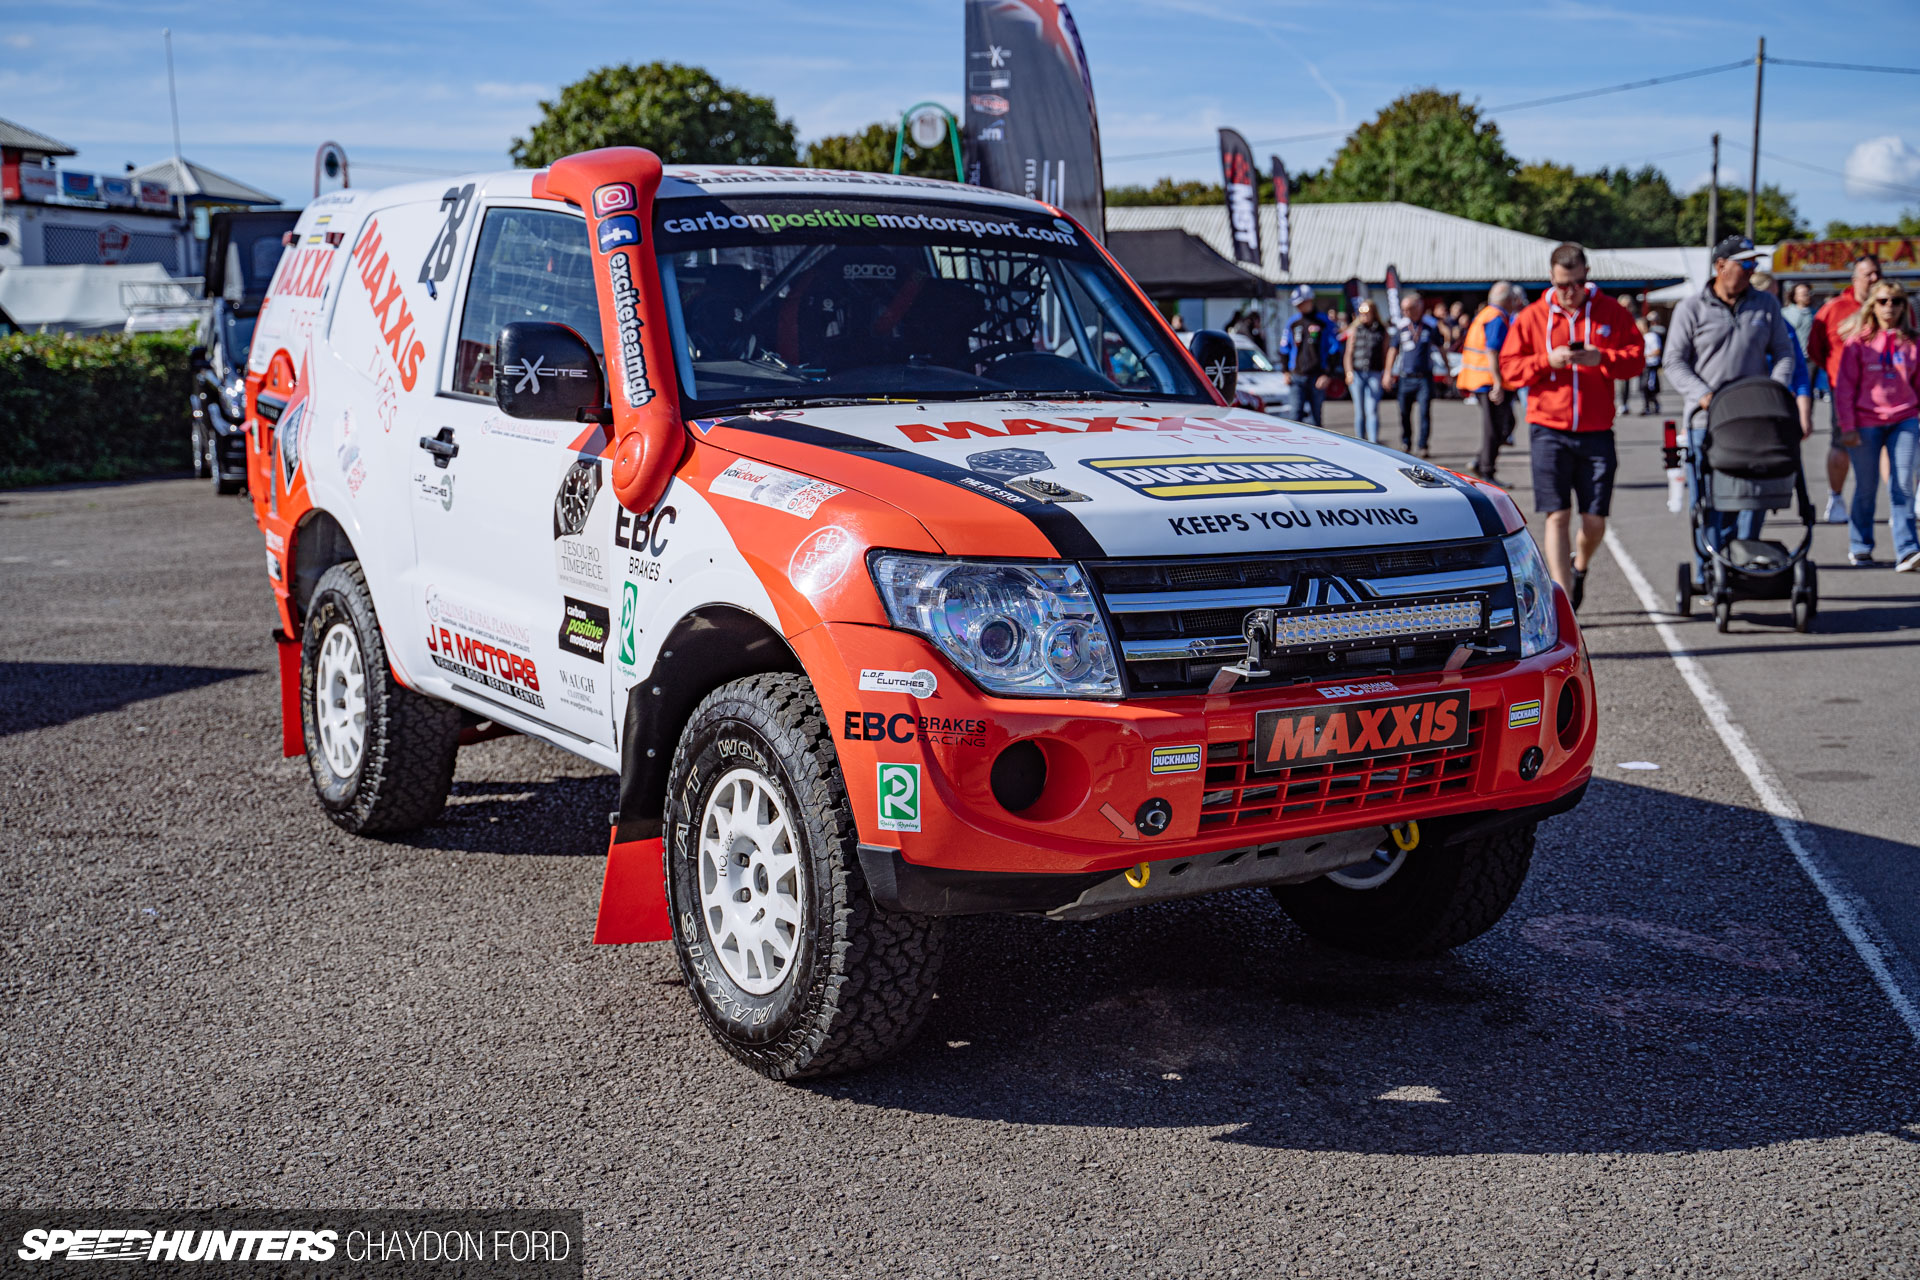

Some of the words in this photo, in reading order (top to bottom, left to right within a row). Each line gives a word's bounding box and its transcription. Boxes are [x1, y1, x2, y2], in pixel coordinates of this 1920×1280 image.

[418, 183, 475, 283] 28
[664, 209, 1079, 248] carbonpositivemotorsport.com
[843, 264, 896, 281] sparco
[353, 218, 425, 392] MAXXIS
[609, 252, 656, 408] exciteteamgb
[503, 354, 588, 395] EXCITE
[368, 345, 398, 433] TYRES
[895, 416, 1293, 443] MAXXIS
[1157, 433, 1341, 446] TYRES
[723, 467, 769, 484] voxcloud
[1108, 463, 1355, 487] DUCKHAMS
[960, 477, 985, 488] THE
[996, 490, 1027, 504] STOP
[615, 502, 677, 557] EBC
[1168, 512, 1250, 536] KEEPS
[1251, 509, 1312, 531] YOU
[1316, 507, 1419, 528] MOVING
[562, 539, 600, 562] TESOURO
[561, 555, 604, 580] TIMEPIECE
[628, 556, 661, 582] BRAKES
[566, 618, 604, 640] positive
[570, 634, 604, 653] motorsport
[455, 633, 540, 692] MOTORS
[862, 671, 885, 679] L.O.F
[434, 656, 465, 676] VEHICLE
[465, 668, 486, 684] BODY
[486, 676, 514, 694] REPAIR
[514, 687, 544, 708] CENTRE
[560, 669, 595, 694] WAUGH
[876, 678, 925, 688] CLUTCHES
[1316, 684, 1365, 699] EBC
[844, 711, 915, 743] EBC
[918, 716, 986, 733] BRAKES
[1511, 707, 1539, 721] DUCKHAMS
[917, 734, 986, 748] RACING
[1267, 699, 1460, 763] MAXXIS
[1153, 753, 1199, 767] DUCKHAMS
[681, 911, 774, 1026] MAXXIS
